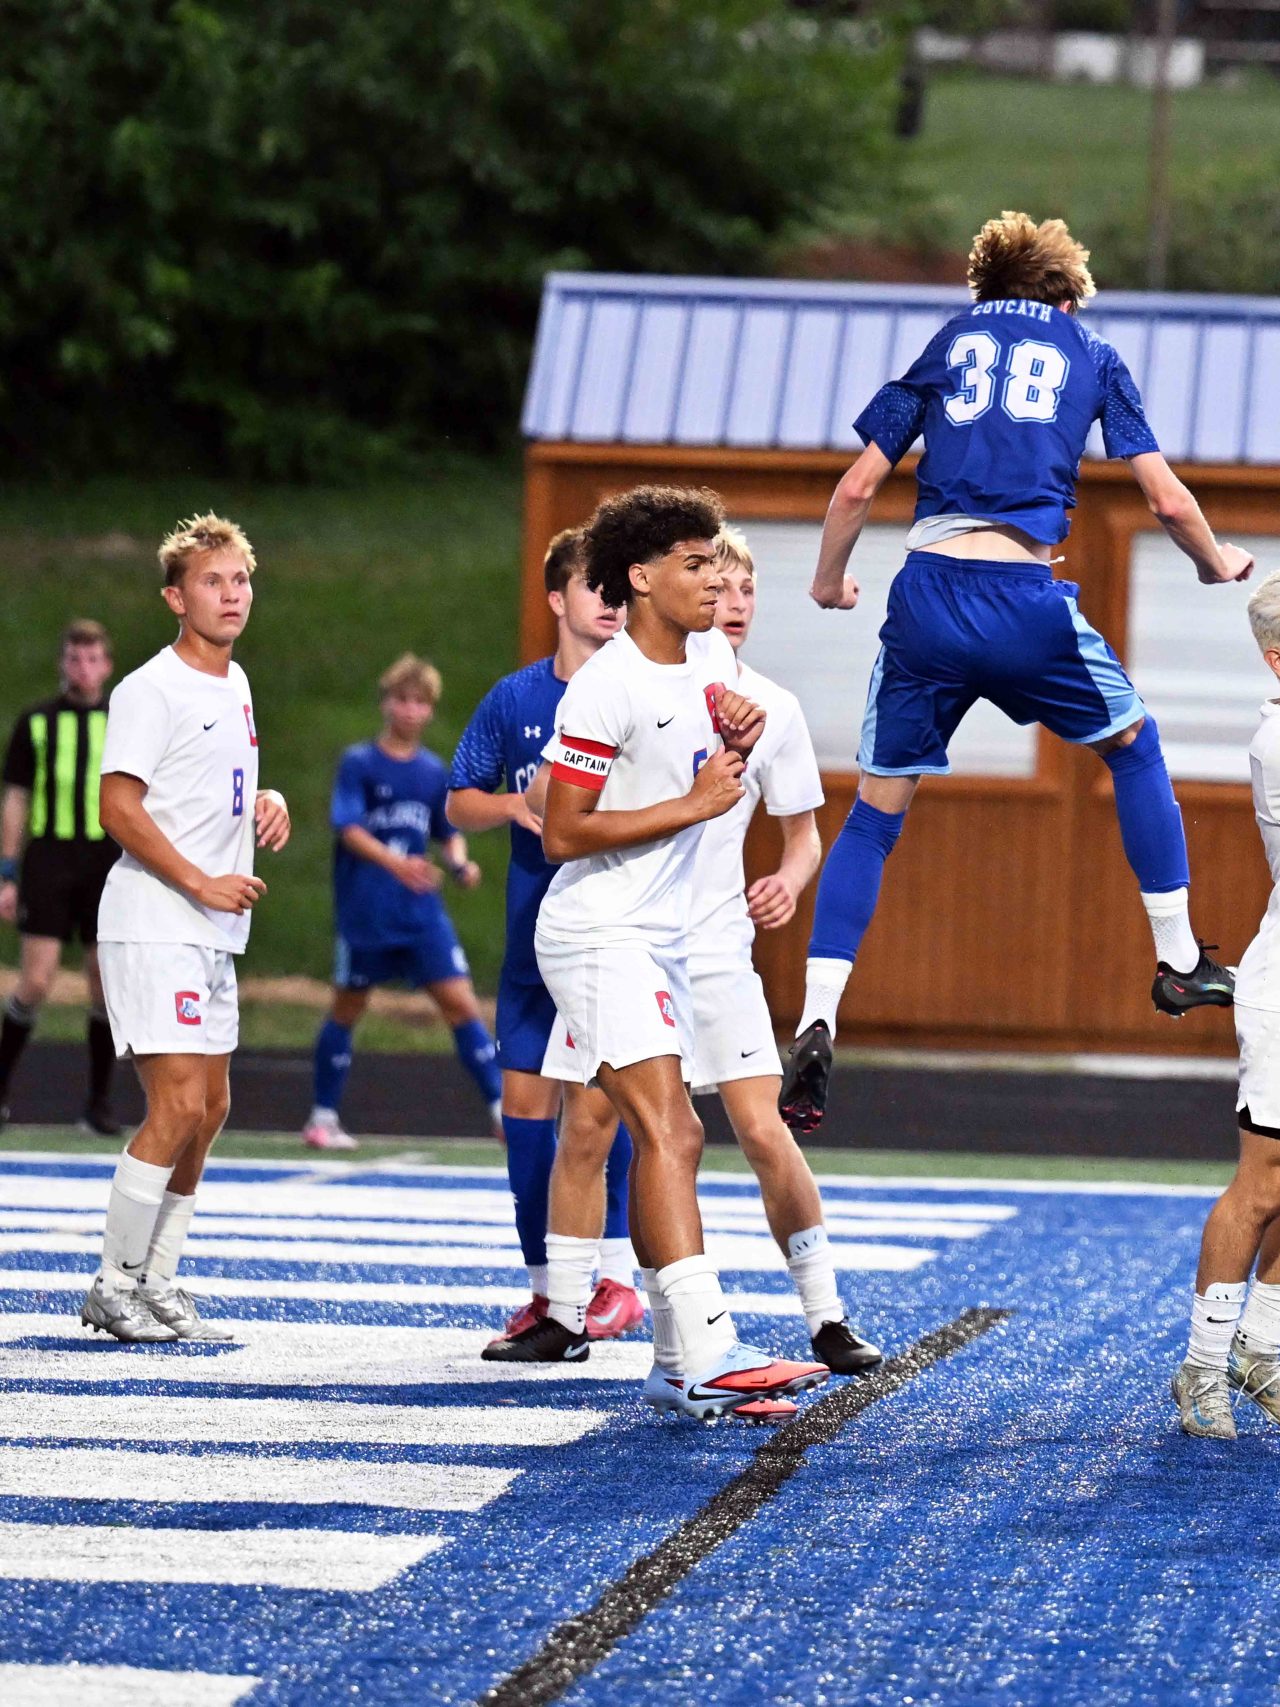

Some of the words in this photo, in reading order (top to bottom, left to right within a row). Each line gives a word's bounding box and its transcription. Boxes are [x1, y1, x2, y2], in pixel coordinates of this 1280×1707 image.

[971, 299, 1051, 322] COVCATH
[944, 330, 1070, 426] 38
[564, 750, 607, 772] CAPTAIN
[232, 768, 244, 816] 8
[174, 991, 202, 1025] C
